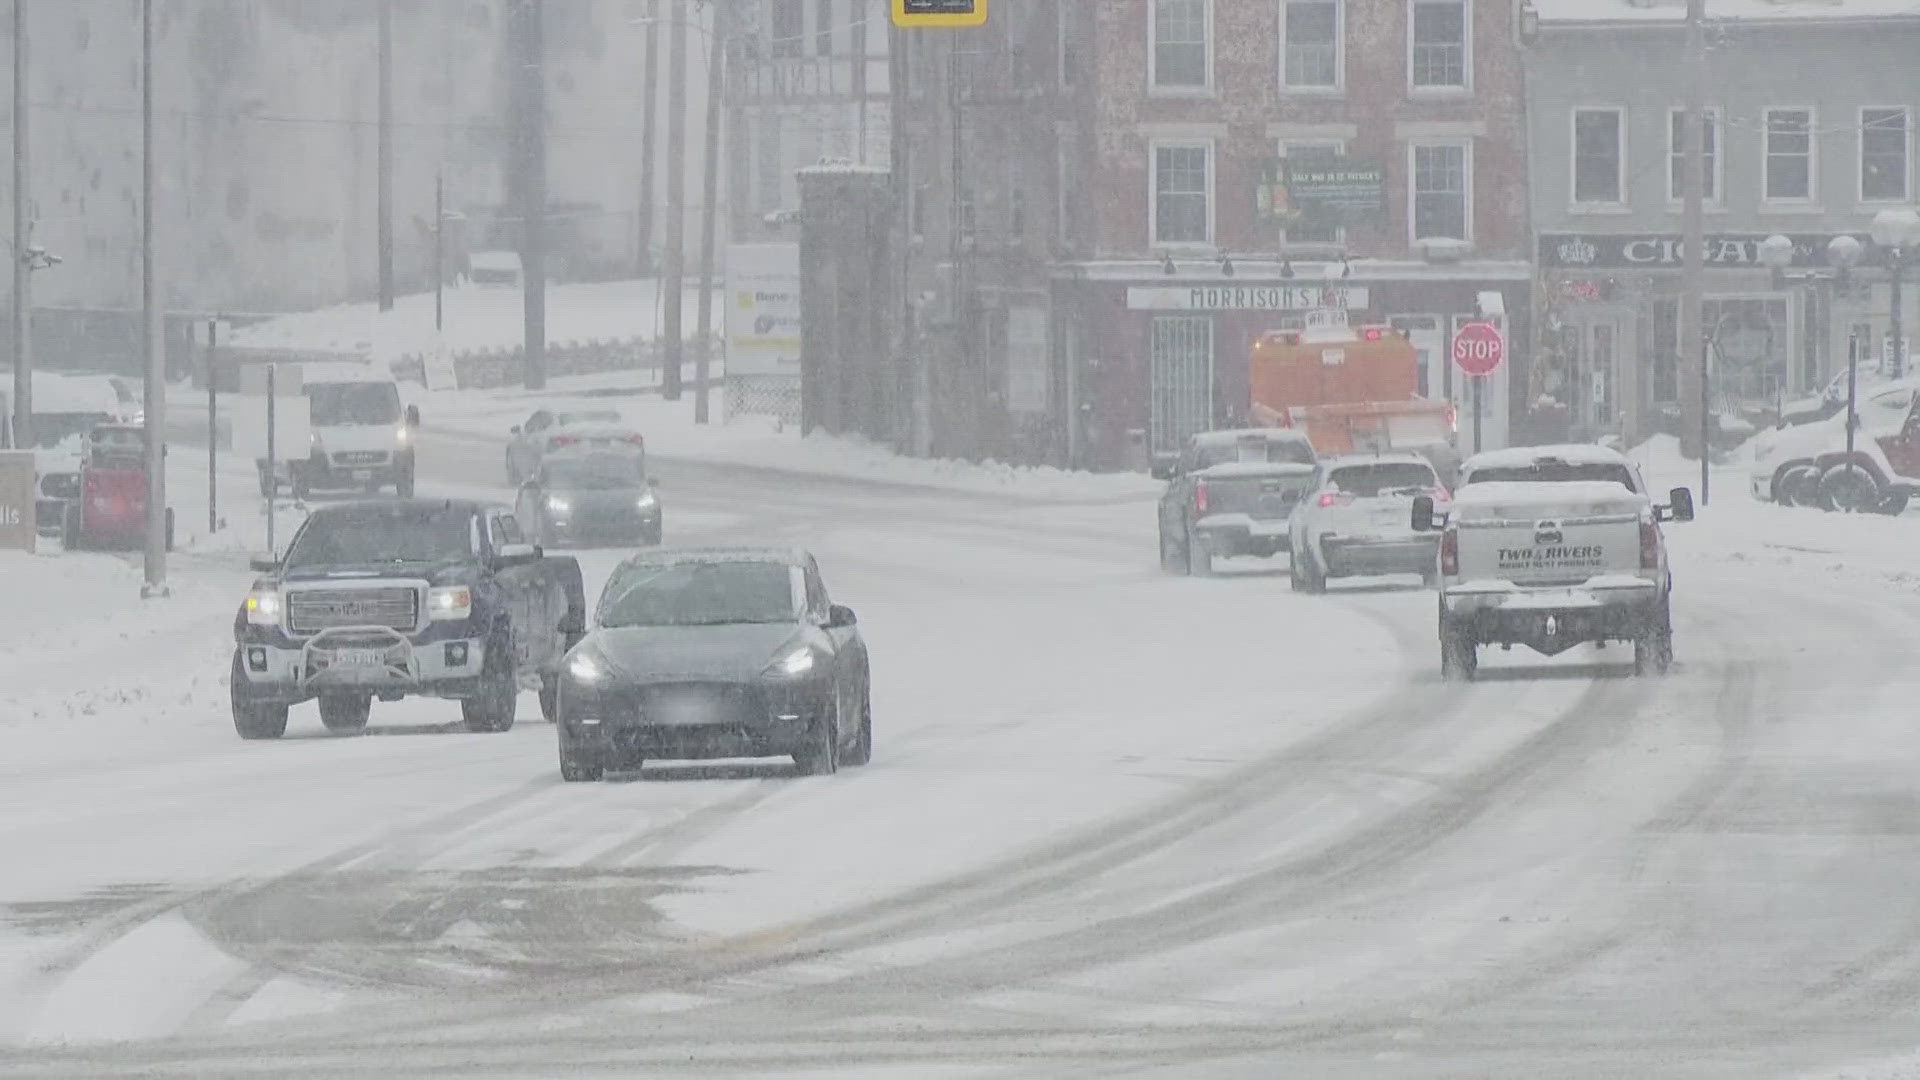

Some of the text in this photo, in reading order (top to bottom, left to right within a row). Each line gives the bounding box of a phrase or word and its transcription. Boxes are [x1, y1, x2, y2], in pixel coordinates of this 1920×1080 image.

[1456, 340, 1500, 359] STOP
[1497, 545, 1603, 561] TWO RIVERS
